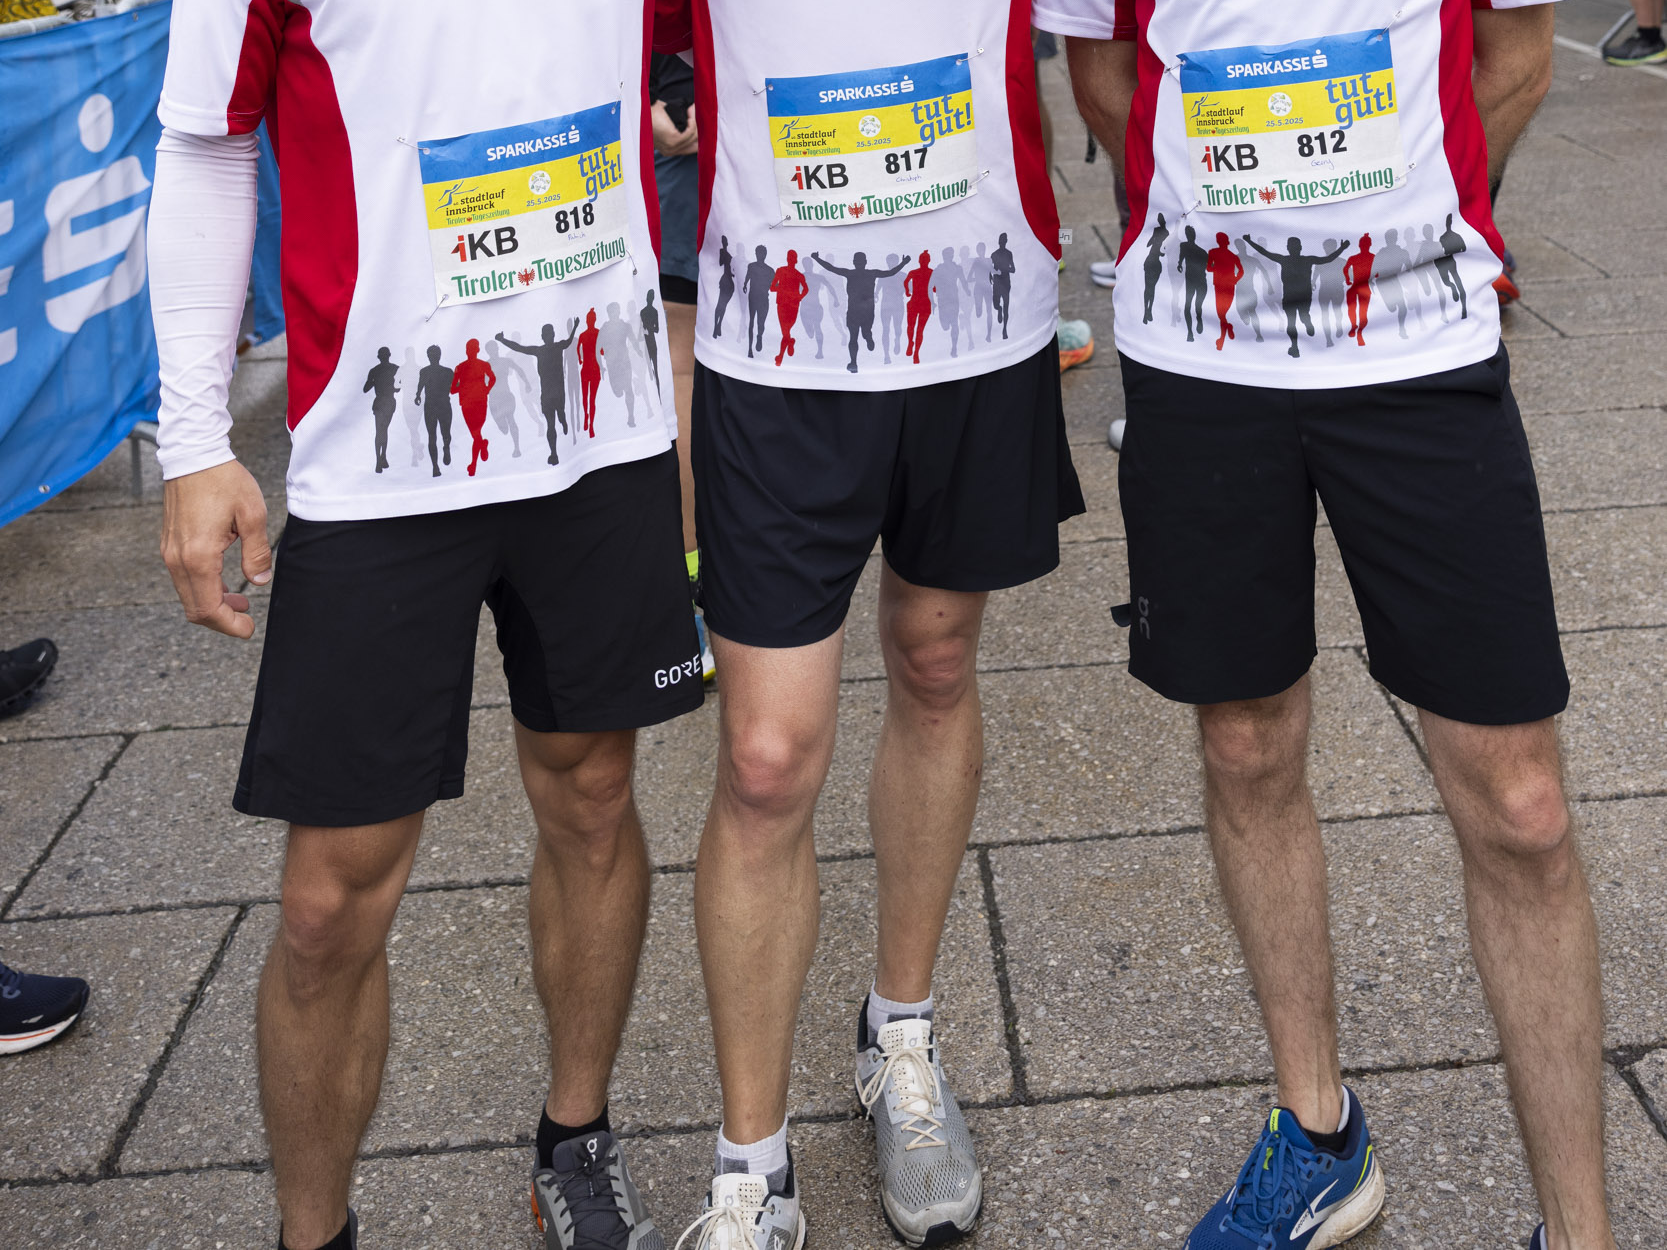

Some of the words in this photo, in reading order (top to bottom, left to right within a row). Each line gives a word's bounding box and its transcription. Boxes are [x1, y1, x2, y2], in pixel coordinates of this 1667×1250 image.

[1226, 56, 1311, 78] SPARKASSE
[818, 82, 899, 103] SPARKASSE
[1324, 72, 1373, 104] tut
[911, 94, 953, 125] tut
[1205, 106, 1245, 117] stadtlauf
[1335, 82, 1394, 130] gut!
[797, 129, 836, 139] stadtlauf
[919, 101, 972, 148] gut!
[1196, 116, 1235, 127] innsbruck
[1265, 117, 1304, 127] 25.5.2025
[486, 132, 568, 161] SPARKASSE
[785, 138, 827, 148] innsbruck
[856, 137, 892, 148] 25.5.2025
[1297, 129, 1347, 157] 812
[578, 144, 610, 178] tut
[885, 147, 928, 175] 817
[585, 152, 623, 203] gut!
[1202, 183, 1257, 206] Tiroler
[1272, 167, 1394, 204] Tageszeitung
[446, 200, 495, 216] innsbruck
[460, 188, 506, 206] stadtlauf
[526, 193, 561, 207] 25.5.2025
[792, 199, 847, 221] Tiroler
[861, 178, 968, 217] Tageszeitung
[555, 202, 595, 233] 818
[451, 268, 517, 298] Tiroler
[531, 236, 626, 281] Tageszeitung
[654, 653, 701, 689] GORE
